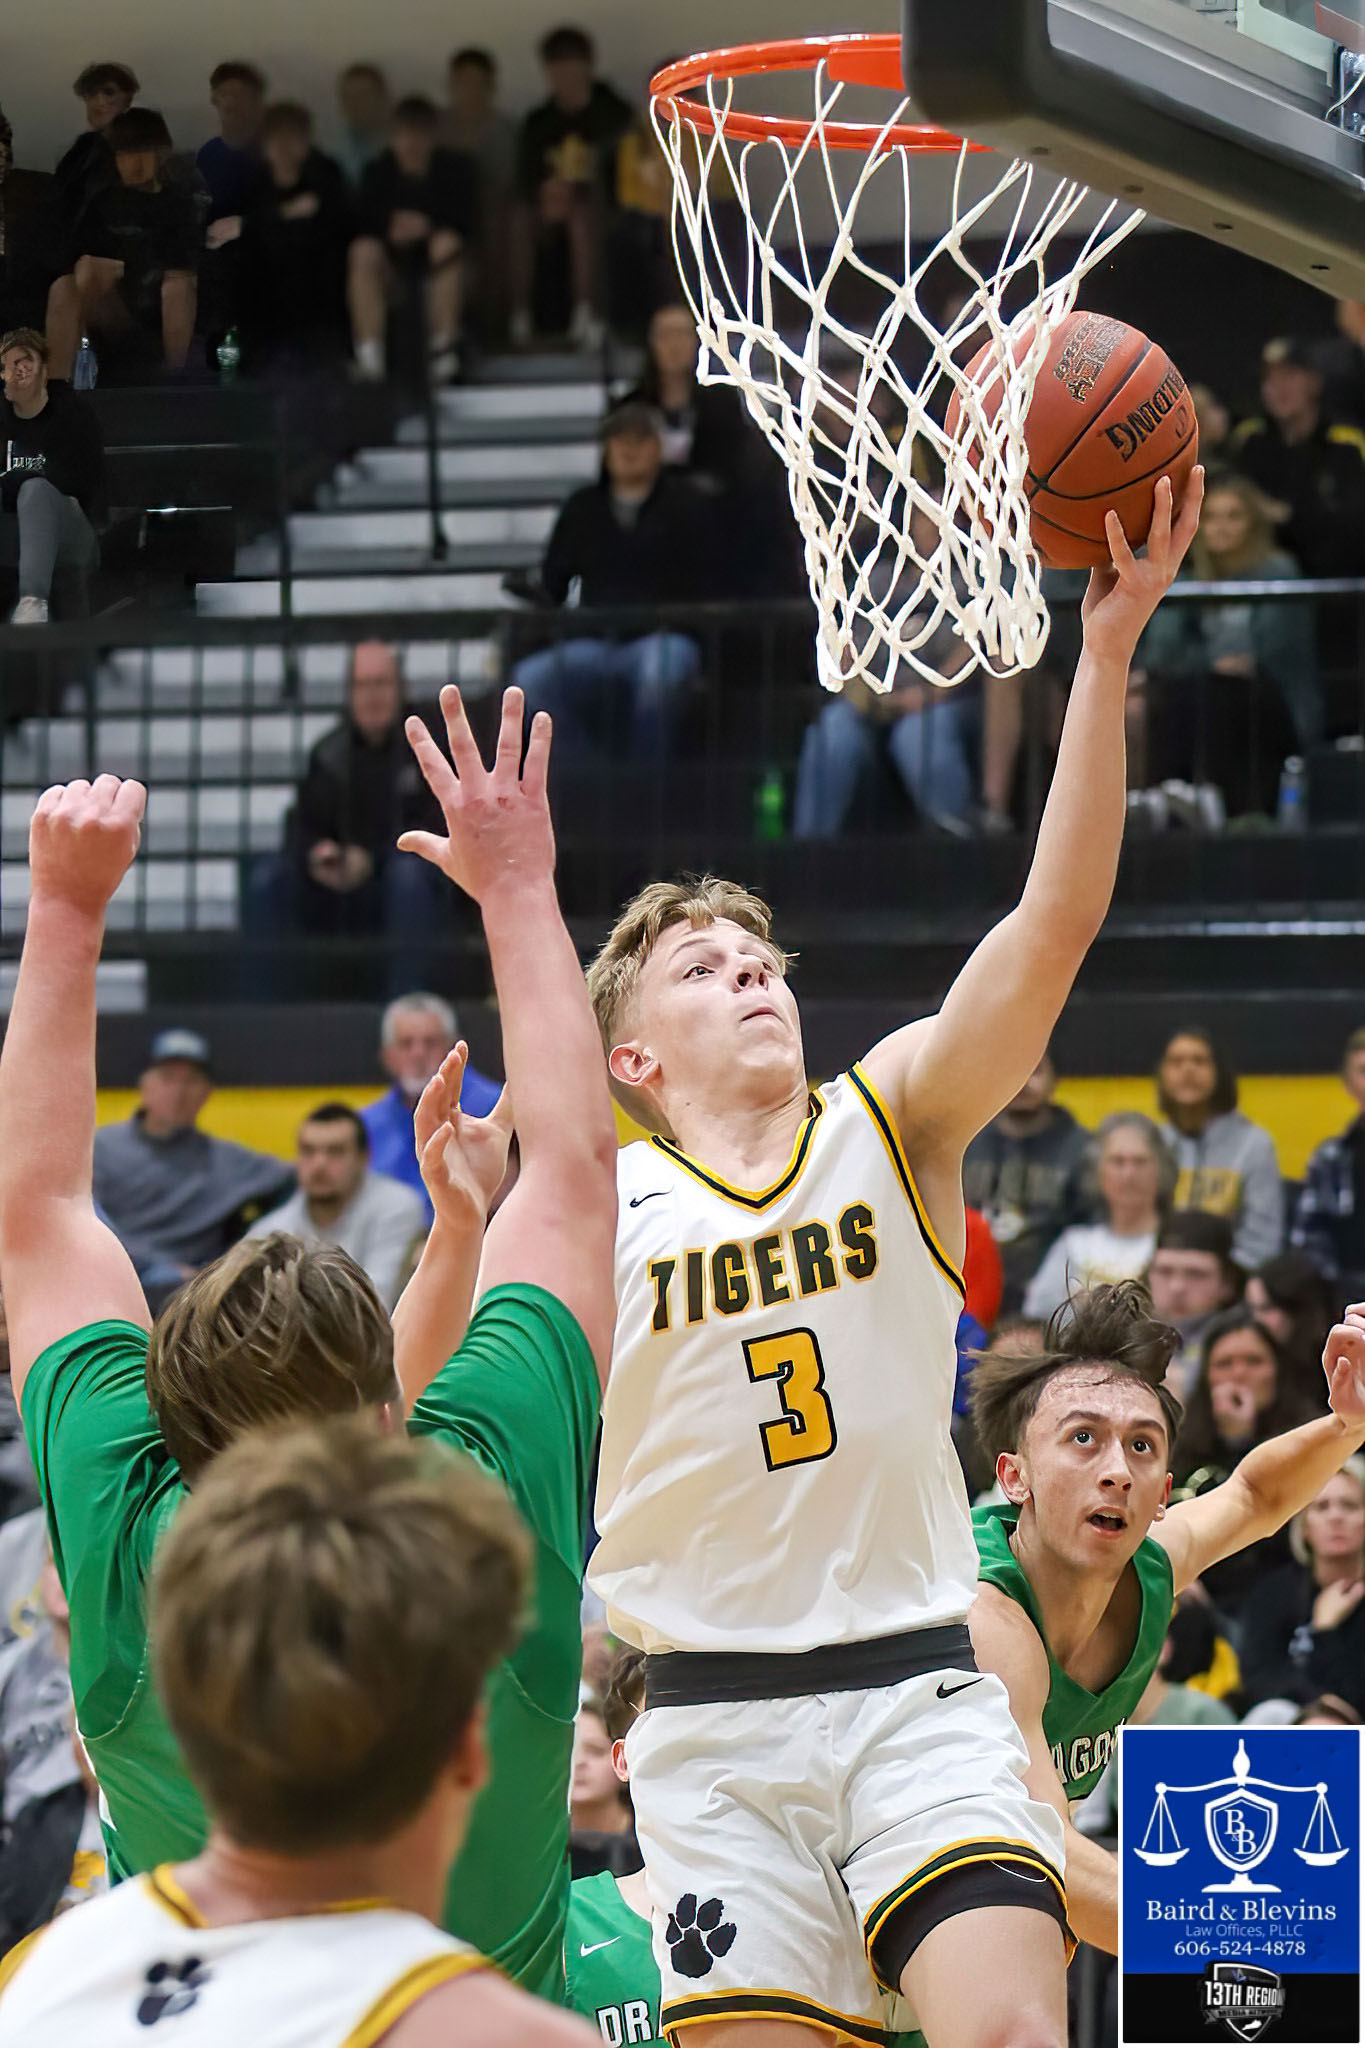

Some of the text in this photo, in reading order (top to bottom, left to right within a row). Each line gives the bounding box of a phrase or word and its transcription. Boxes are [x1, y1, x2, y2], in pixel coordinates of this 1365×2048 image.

[647, 1199, 878, 1334] TIGERS
[741, 1327, 838, 1473] 3
[596, 1999, 663, 2048] DR
